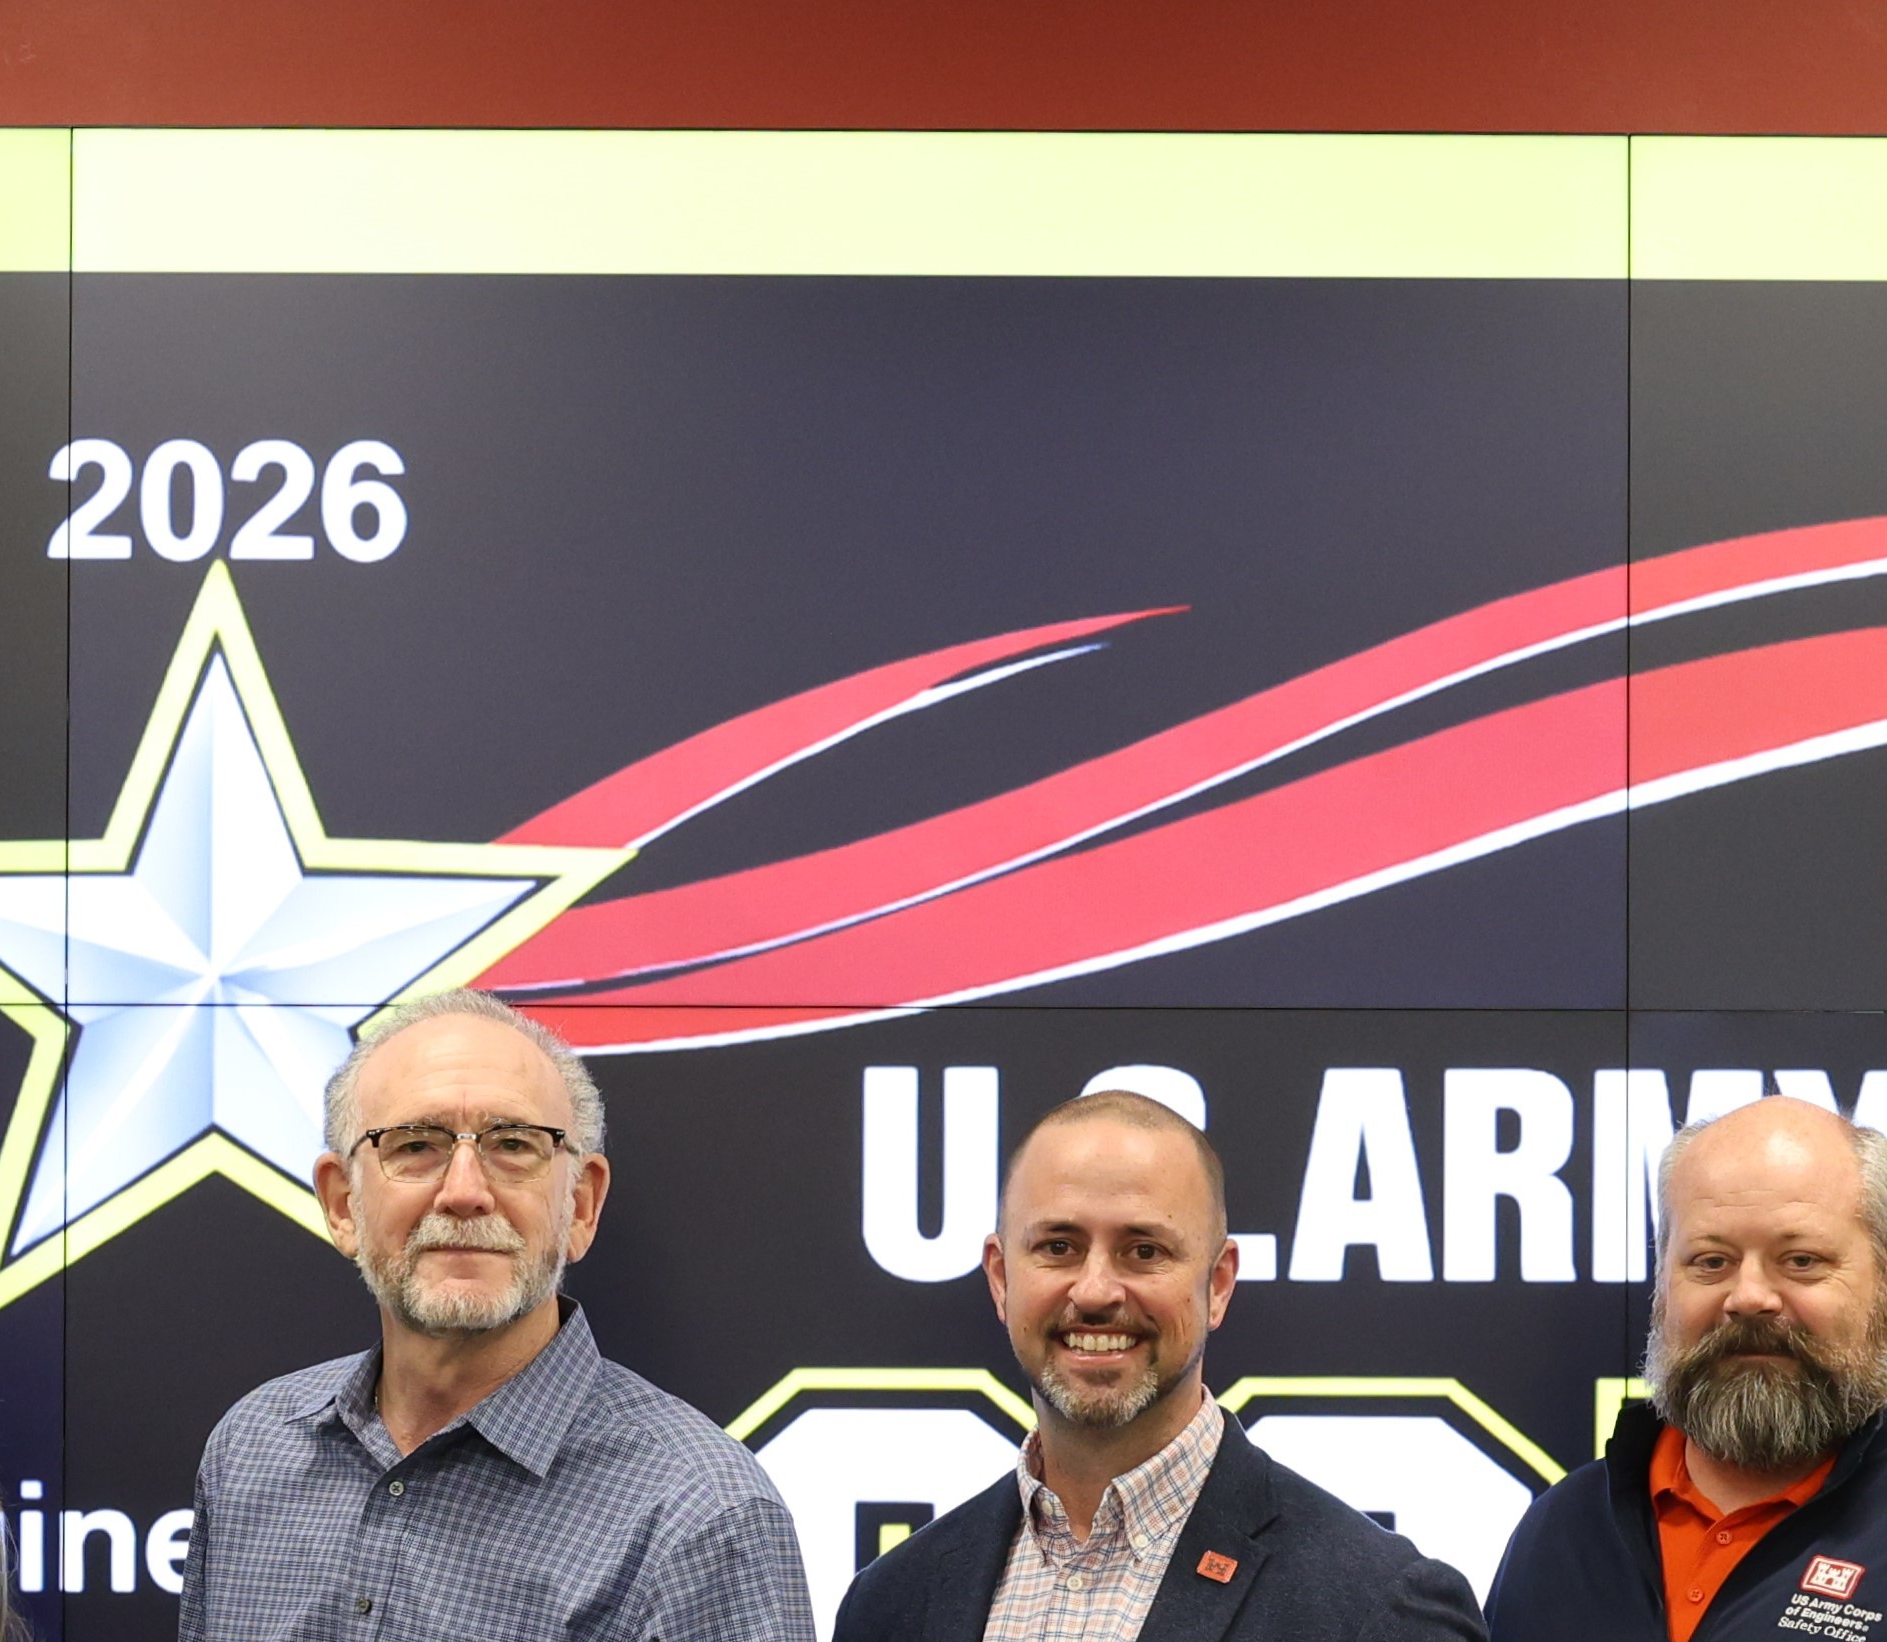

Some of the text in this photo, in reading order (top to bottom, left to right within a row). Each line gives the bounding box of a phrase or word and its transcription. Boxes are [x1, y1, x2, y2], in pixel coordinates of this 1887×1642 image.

[46, 438, 409, 562] 2026
[1785, 1606, 1800, 1616] of
[1791, 1593, 1883, 1622] US Army Corps
[1778, 1616, 1822, 1635] Safety
